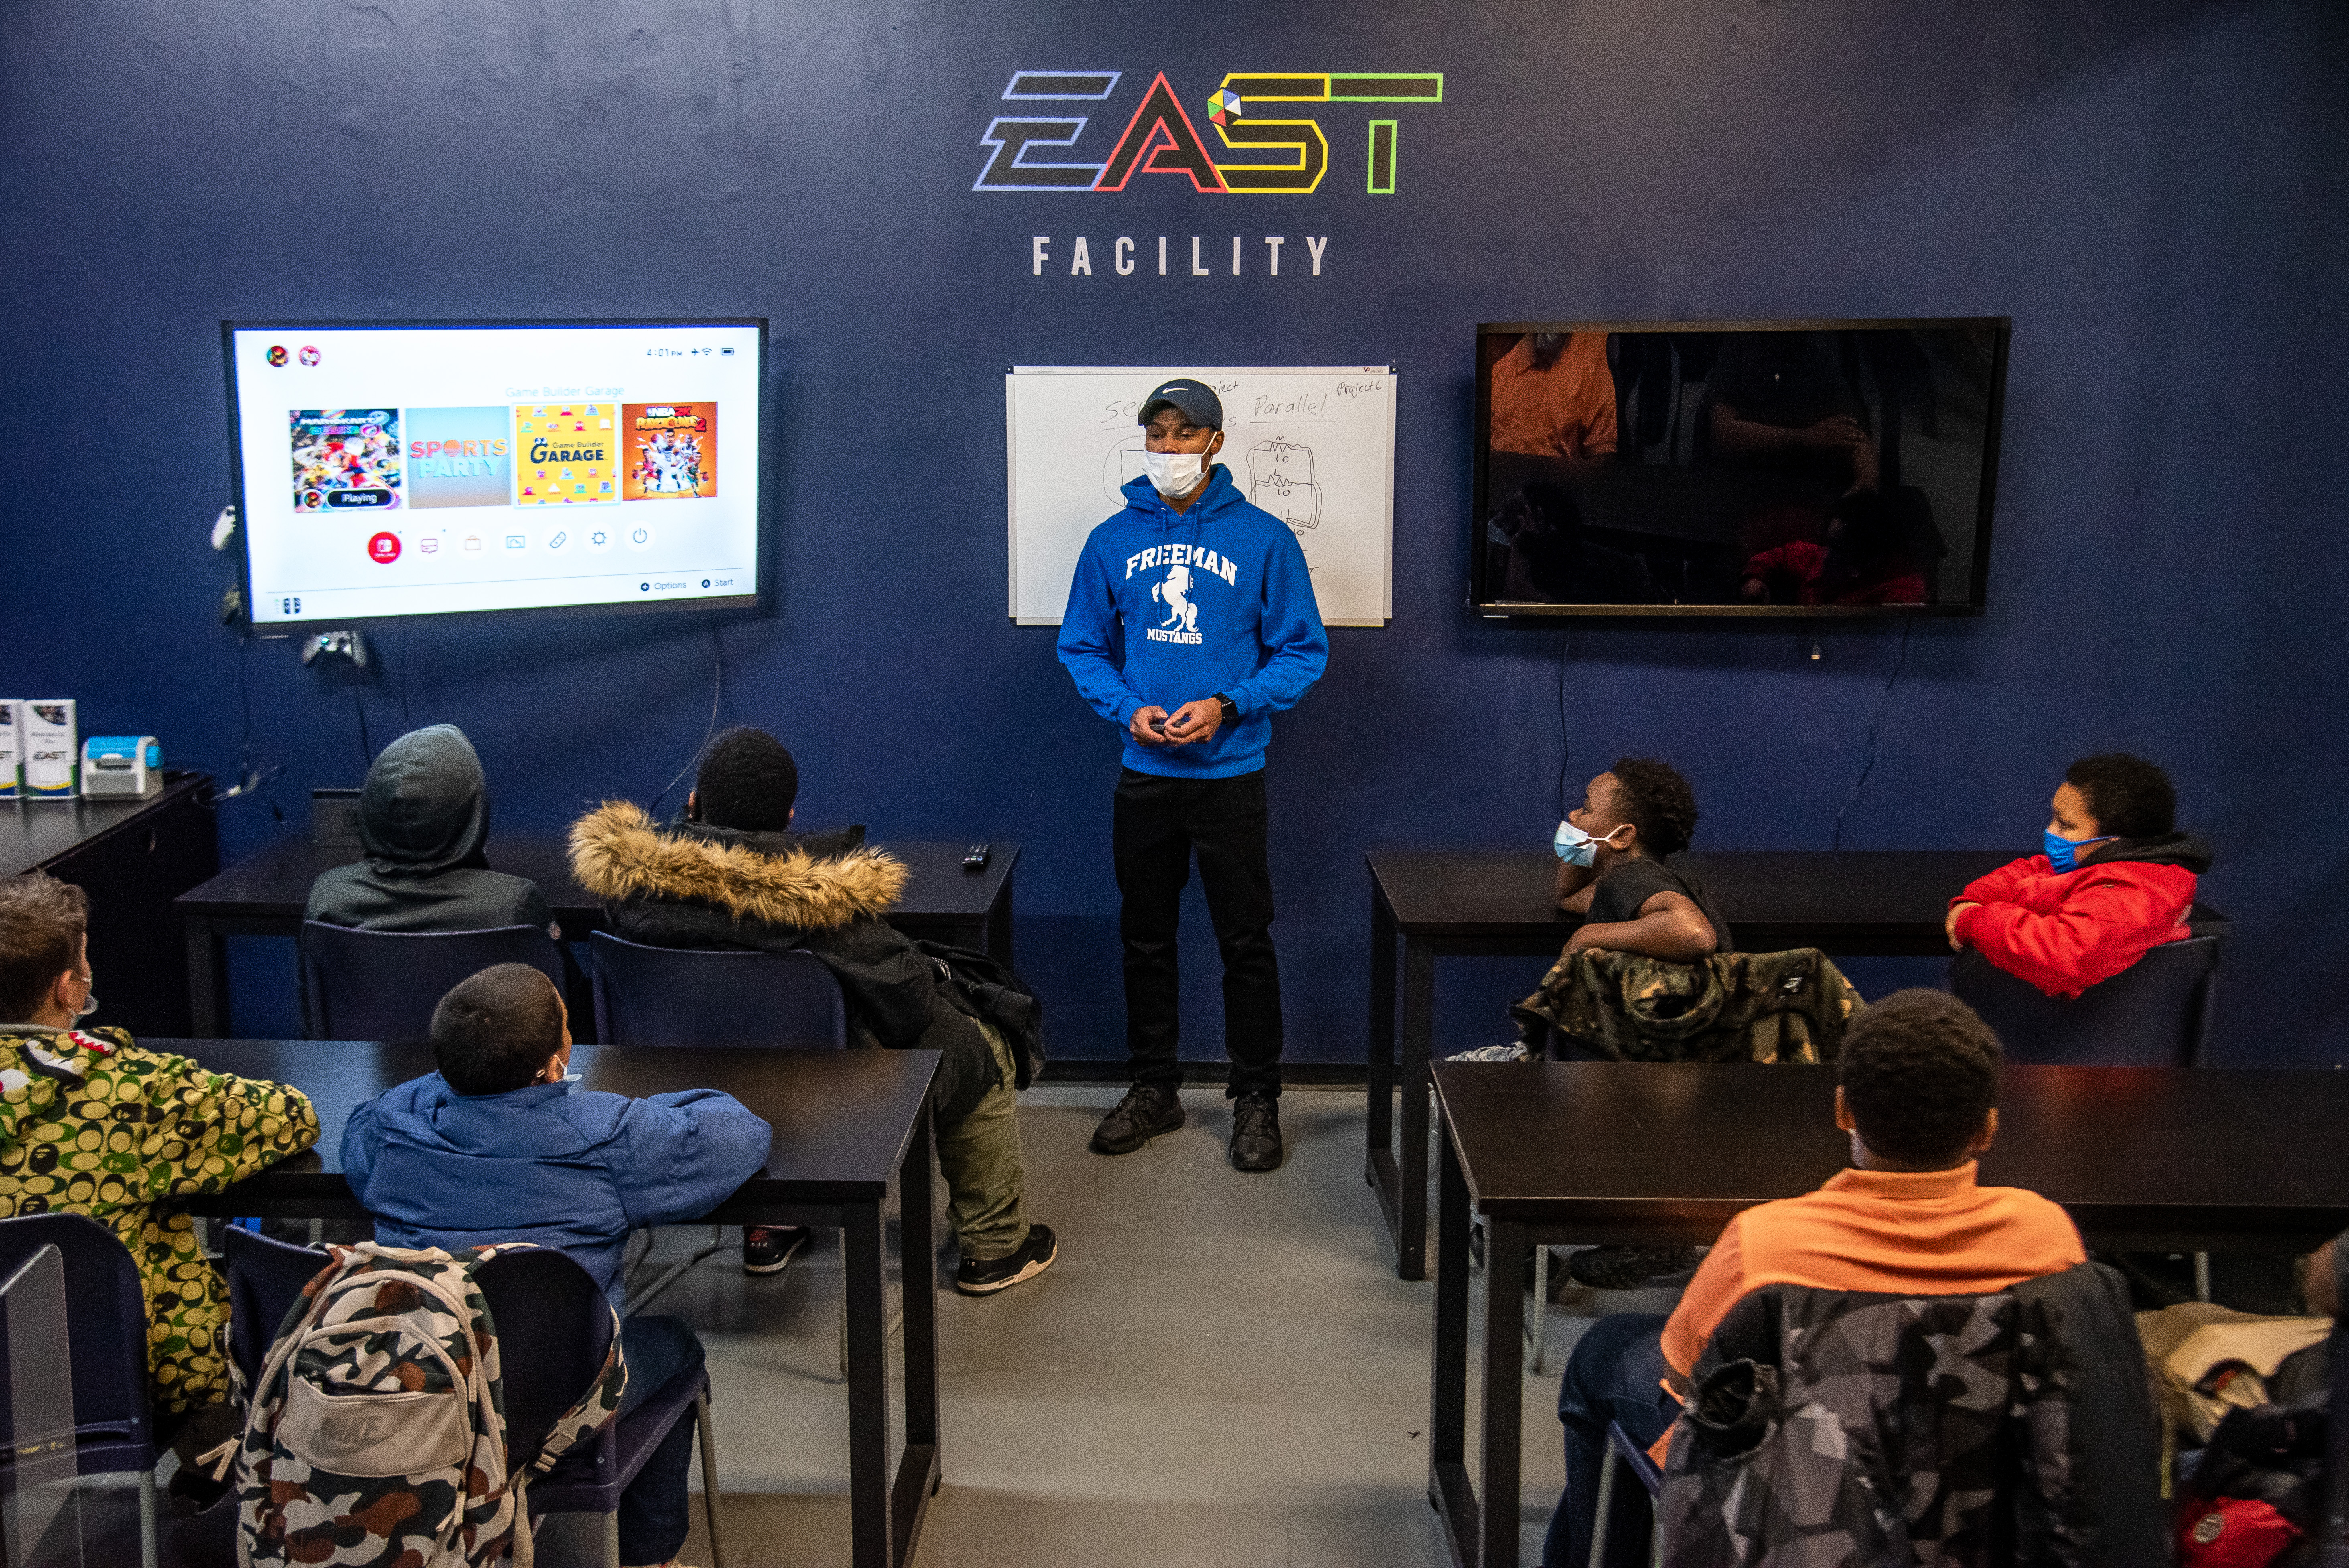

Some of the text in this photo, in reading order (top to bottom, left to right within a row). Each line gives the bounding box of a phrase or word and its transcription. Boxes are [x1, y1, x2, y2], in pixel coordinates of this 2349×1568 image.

[972, 71, 1443, 193] EAST
[1033, 237, 1328, 276] FACILITY
[506, 386, 624, 398] Game Builder Garage
[1209, 381, 1240, 396] oject
[1254, 393, 1327, 417] Parallel
[695, 418, 707, 432] 2
[410, 439, 508, 458] SPORTS
[530, 443, 604, 464] GARAGE
[419, 458, 501, 478] PARTY
[342, 493, 378, 505] Playing
[1125, 544, 1237, 587] FREEMAN
[654, 582, 686, 591] Options
[1146, 628, 1203, 645] MUSTANGS
[320, 1415, 383, 1444] NIKE
